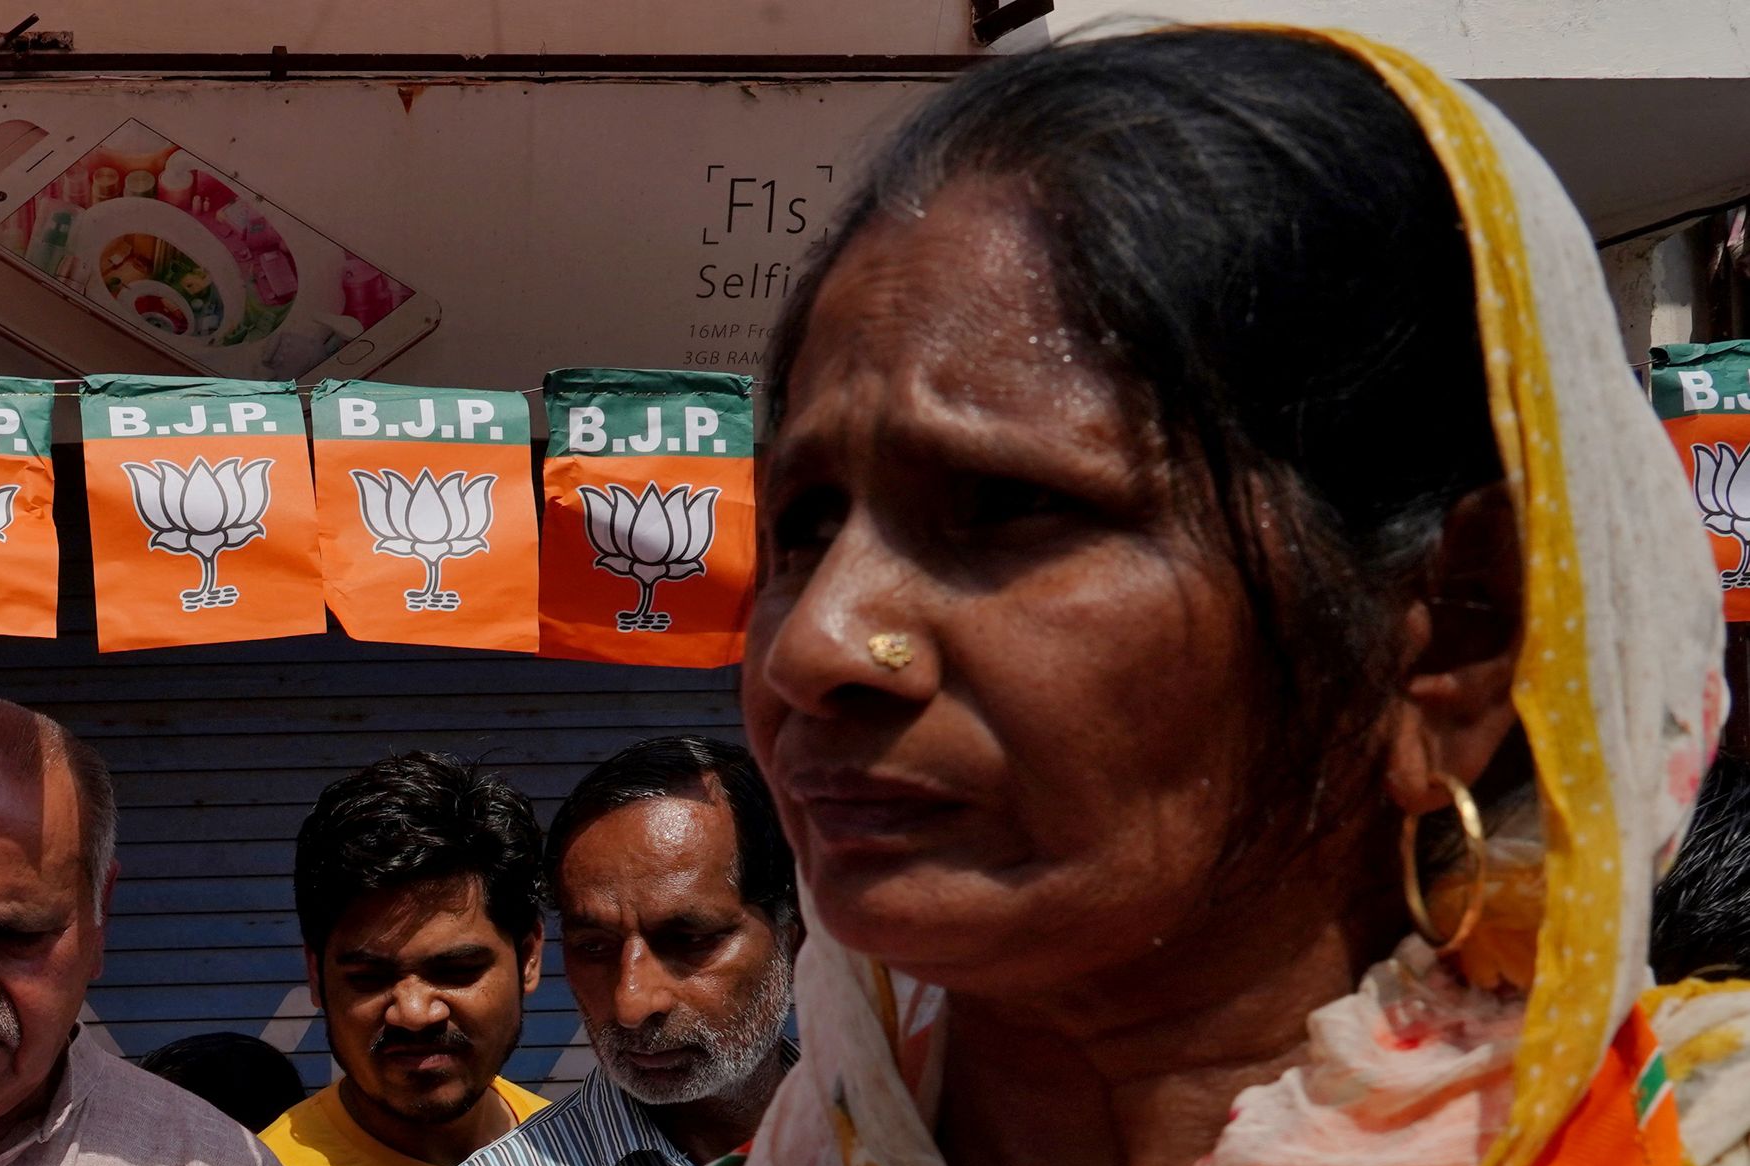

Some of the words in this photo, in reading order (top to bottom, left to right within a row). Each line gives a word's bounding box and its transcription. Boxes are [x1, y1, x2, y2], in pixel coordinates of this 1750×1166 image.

[727, 177, 807, 234] F1s
[696, 263, 800, 299] Selfi
[689, 323, 740, 339] 16MP
[747, 324, 778, 339] Fro
[683, 350, 720, 366] 3GB
[108, 402, 278, 437] B.J.P.
[338, 397, 504, 441] B.J.P.
[568, 406, 727, 455] B.J.P.
